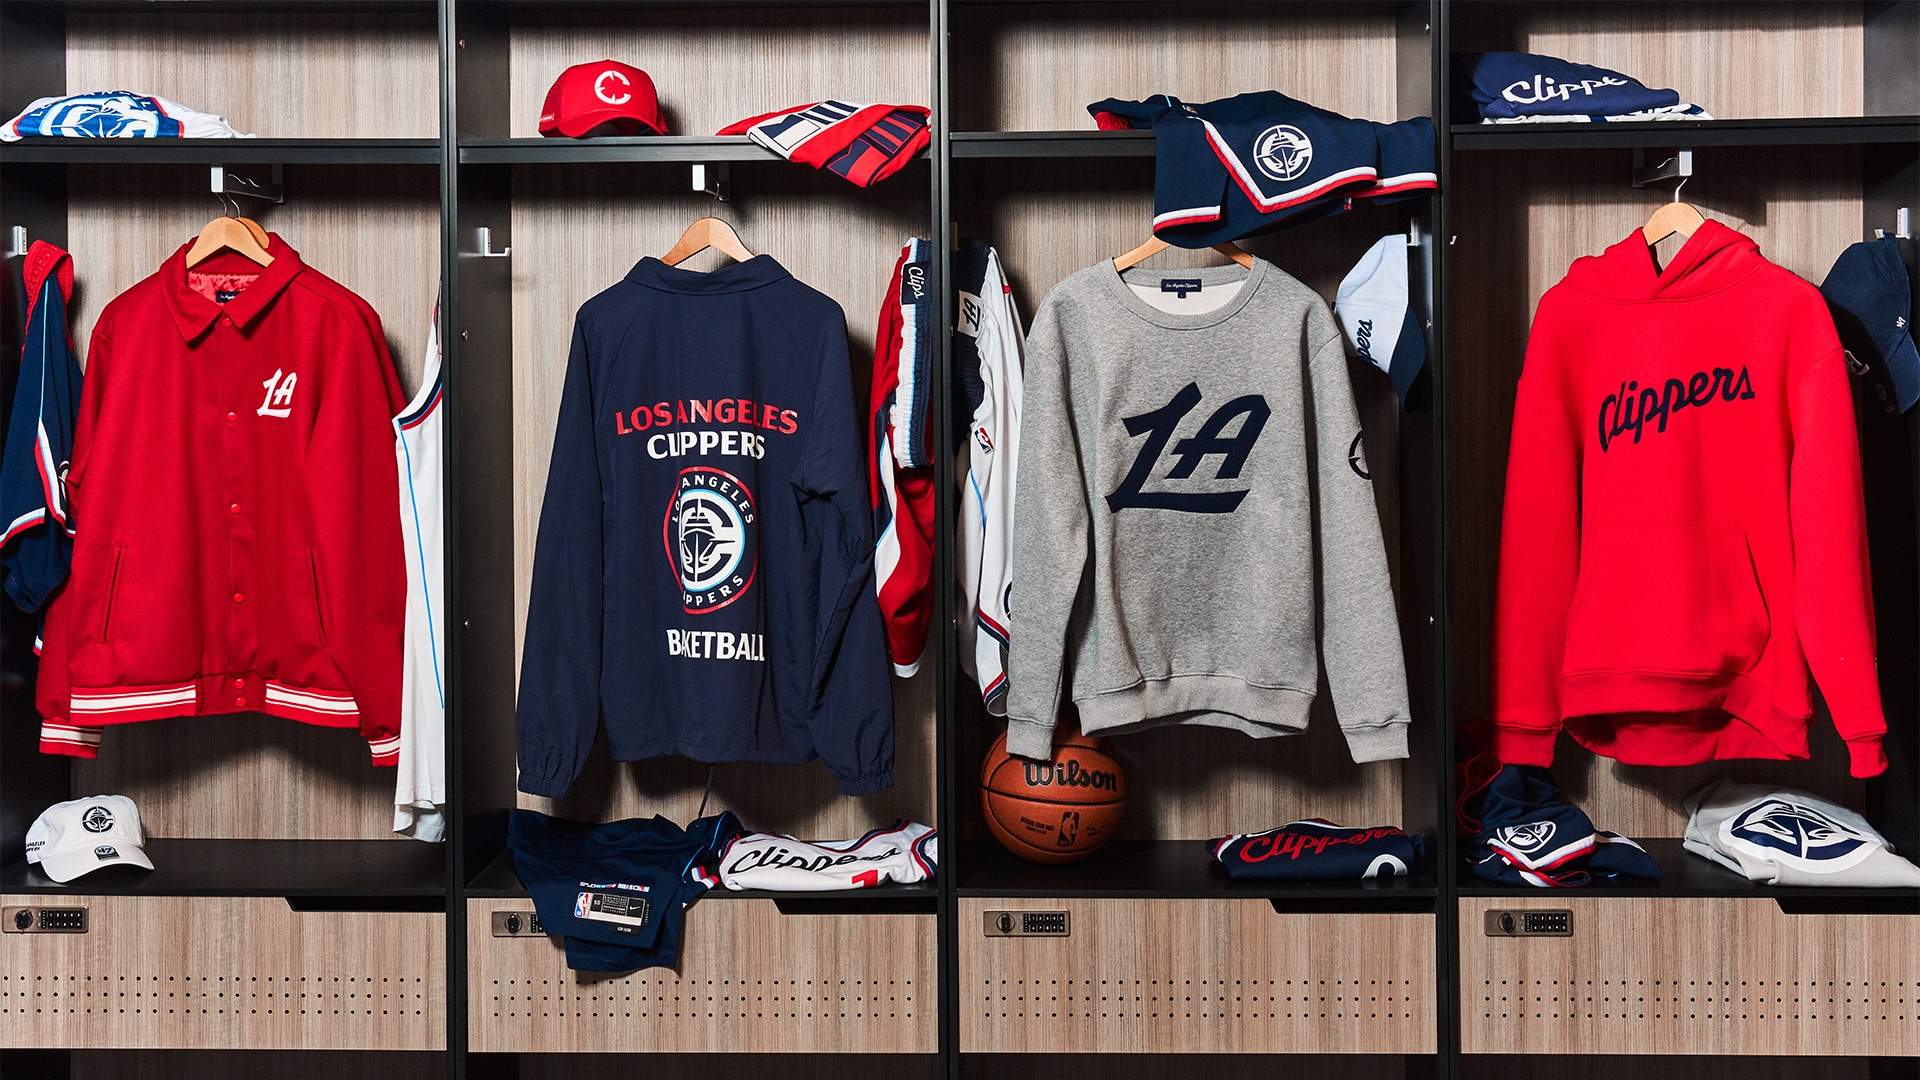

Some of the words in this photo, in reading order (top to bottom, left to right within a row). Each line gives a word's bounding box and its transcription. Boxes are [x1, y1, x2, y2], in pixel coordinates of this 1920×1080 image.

[1501, 74, 1628, 104] Clippe
[906, 266, 925, 299] Clips
[1356, 319, 1378, 366] pers
[256, 367, 298, 418] LA
[1598, 364, 1755, 453] Clippers
[615, 402, 673, 435] LOS
[676, 398, 798, 435] ANGELES
[1105, 381, 1272, 514] LA
[682, 474, 754, 524] ANGELES
[1022, 759, 1117, 791] Wilson
[1239, 829, 1408, 863] Clippers
